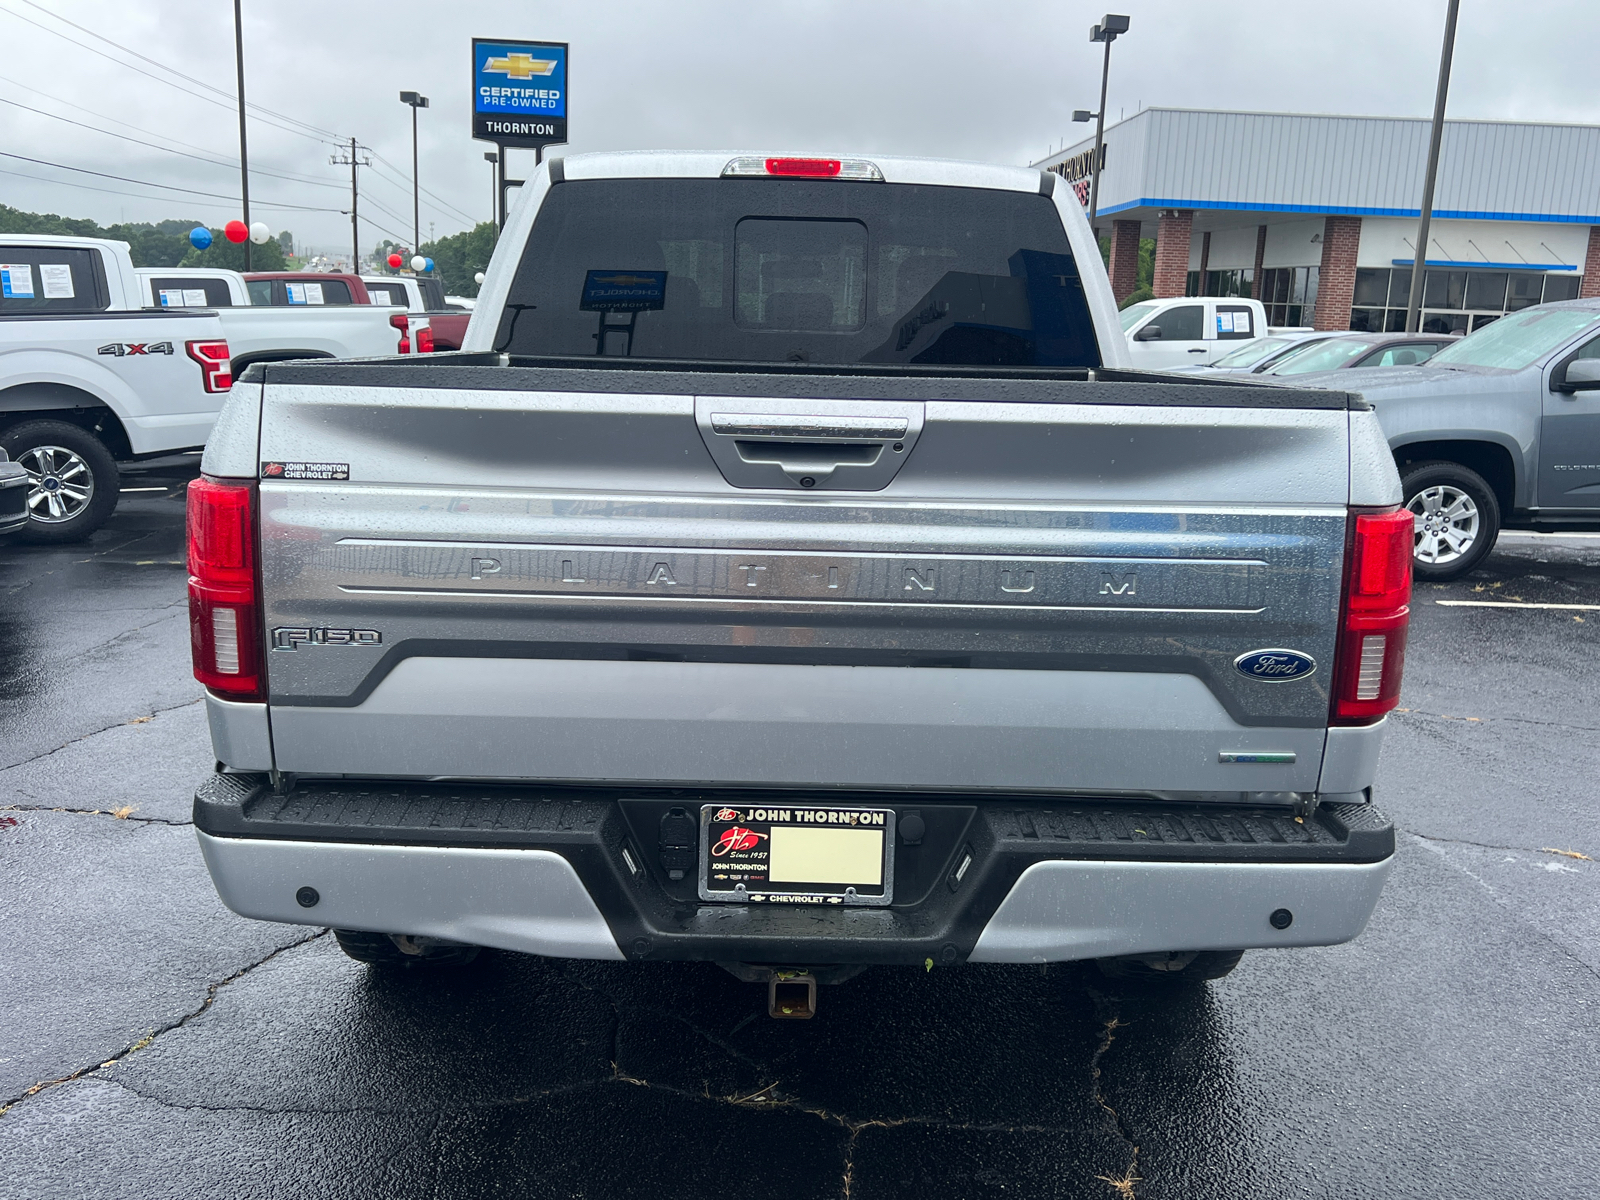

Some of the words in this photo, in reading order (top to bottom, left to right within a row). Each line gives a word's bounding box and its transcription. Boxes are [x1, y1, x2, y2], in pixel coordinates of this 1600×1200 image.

[480, 86, 560, 99] CERTIFIED
[484, 96, 556, 109] PRE-OWNED
[486, 121, 554, 135] THORNTON
[284, 463, 305, 471] JOHN
[306, 464, 348, 472] THORNTON
[284, 470, 332, 479] CHEVROLET
[471, 557, 1137, 595] PLATINUM
[1253, 655, 1299, 674] Ford
[746, 809, 791, 822] JOHN
[794, 810, 884, 825] THORNTON
[729, 851, 749, 859] Since
[712, 862, 730, 870] JOHN
[730, 863, 768, 871] THORNTON
[769, 895, 824, 904] CHEVROLET
